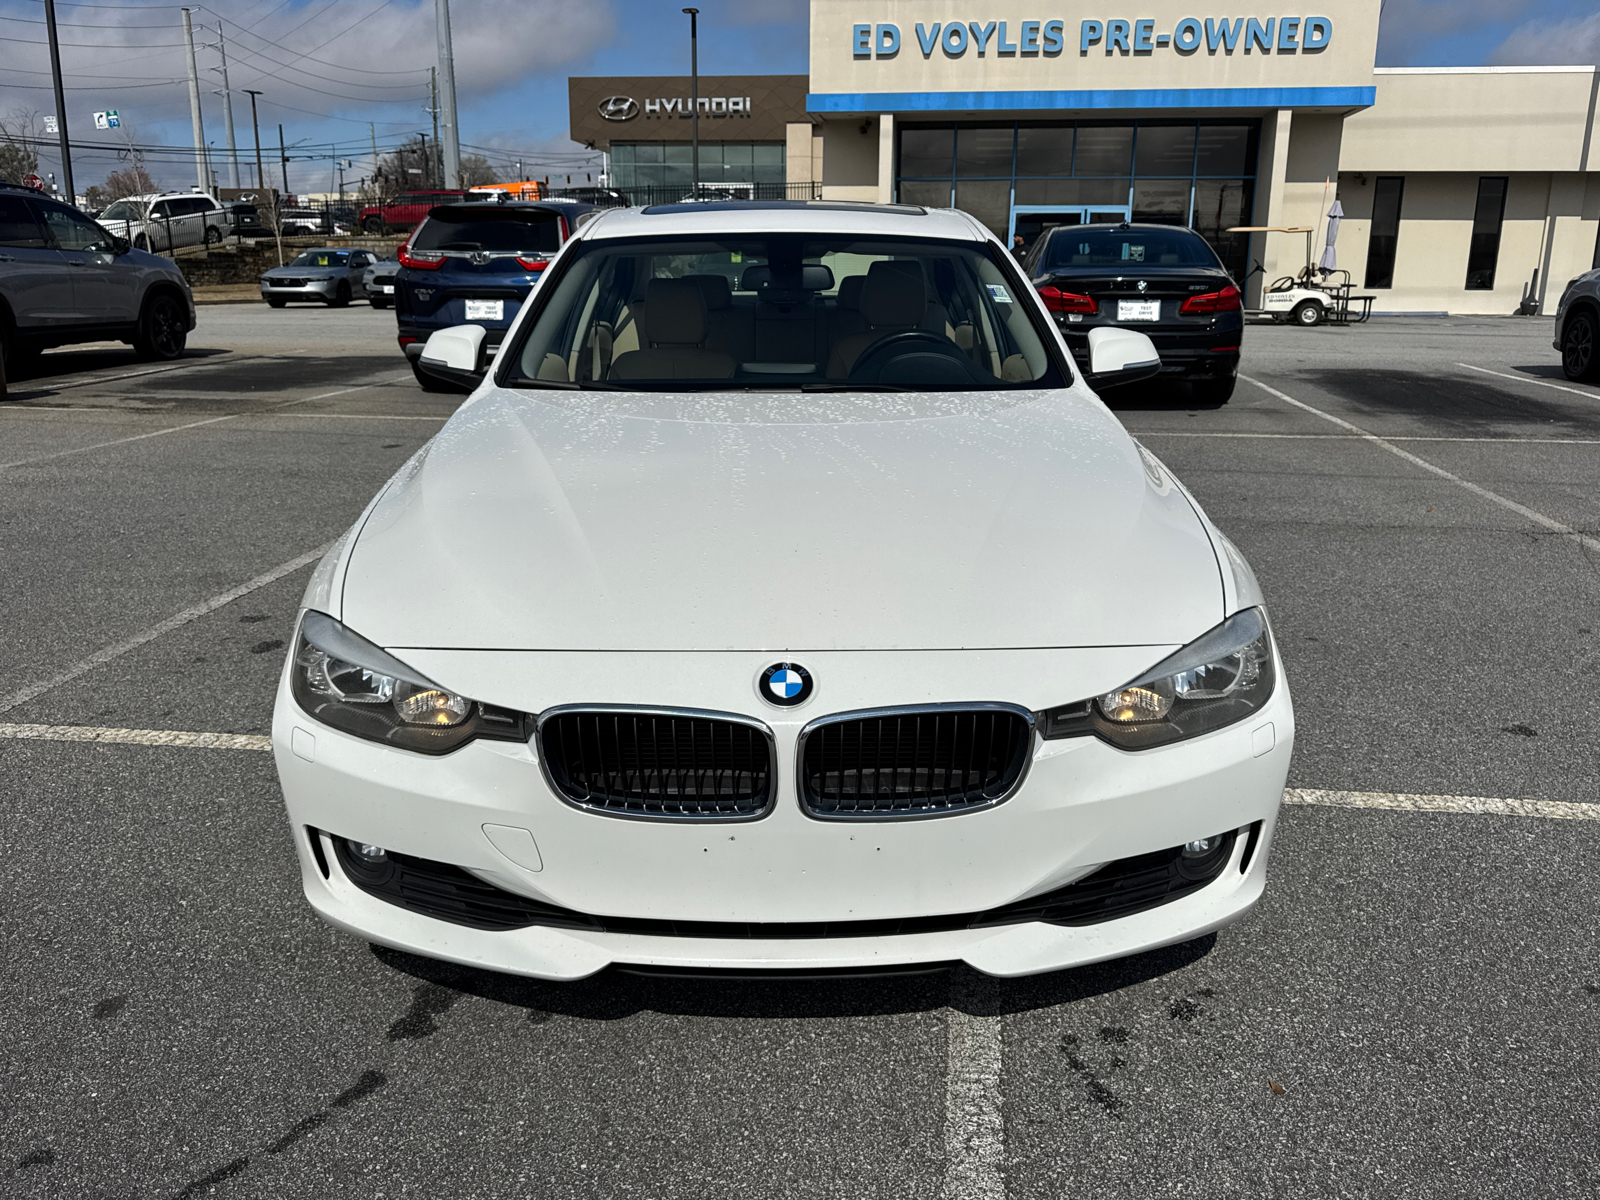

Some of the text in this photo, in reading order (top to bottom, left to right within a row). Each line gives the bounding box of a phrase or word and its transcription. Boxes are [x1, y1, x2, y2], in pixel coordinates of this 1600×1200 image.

[853, 17, 1333, 58] ED VOYLES PRE-OWNED
[644, 97, 751, 116] HYUNDAI
[765, 663, 810, 677] BMW
